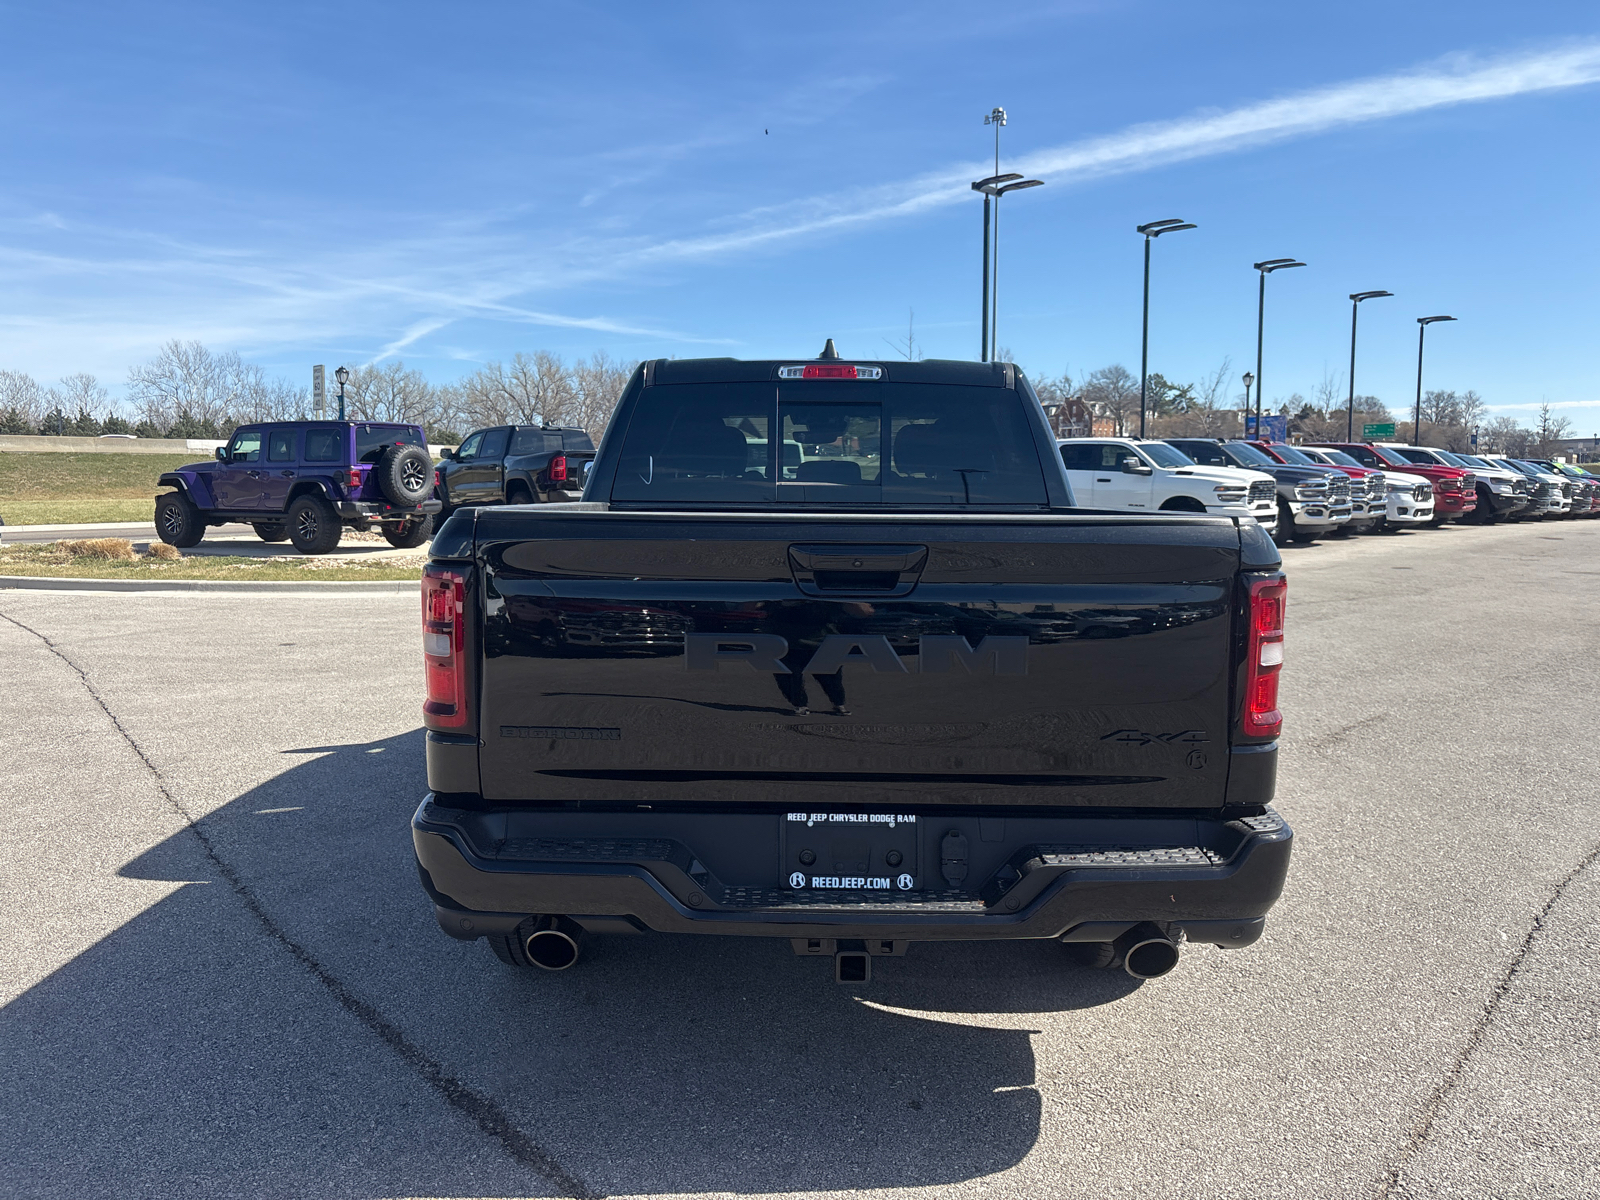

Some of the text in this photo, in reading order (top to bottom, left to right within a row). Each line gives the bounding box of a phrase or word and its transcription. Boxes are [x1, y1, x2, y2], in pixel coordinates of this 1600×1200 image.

[683, 632, 1030, 675] RAM
[787, 813, 916, 823] REED JEEP CHRYSLER DODGE RAM
[812, 876, 891, 889] REEDJEEP.COM
